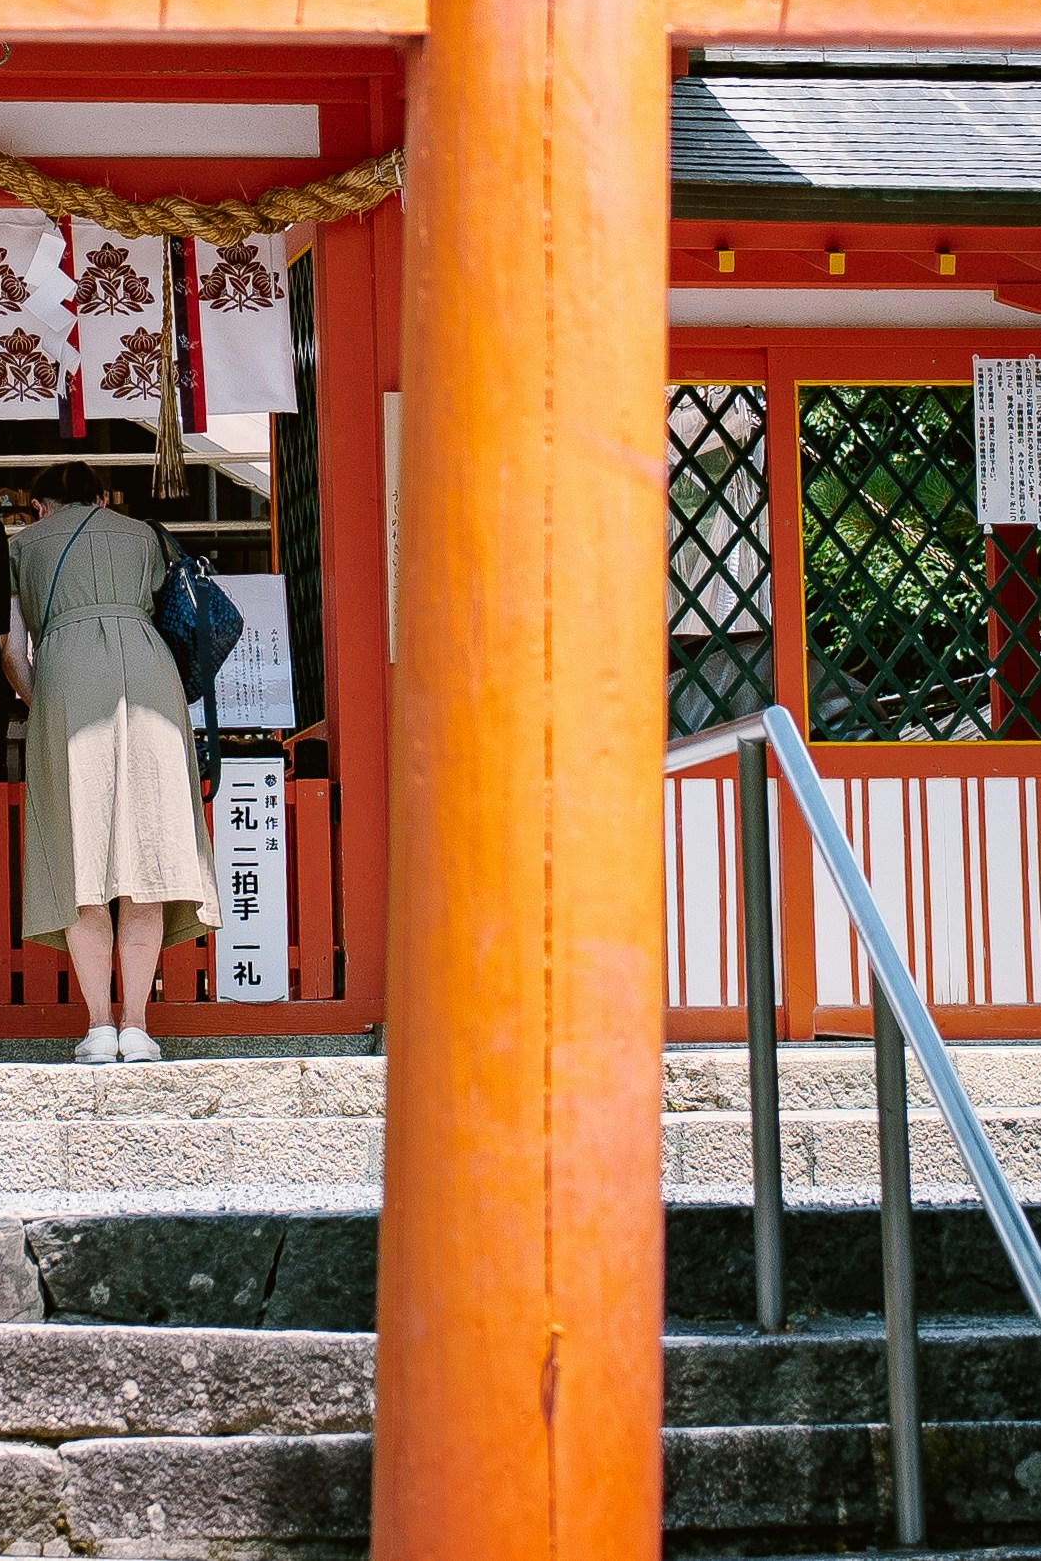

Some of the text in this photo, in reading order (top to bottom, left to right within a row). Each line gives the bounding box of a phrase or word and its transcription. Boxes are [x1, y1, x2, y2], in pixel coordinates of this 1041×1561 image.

[230, 782, 262, 986] 二礼 二拍手 一礼
